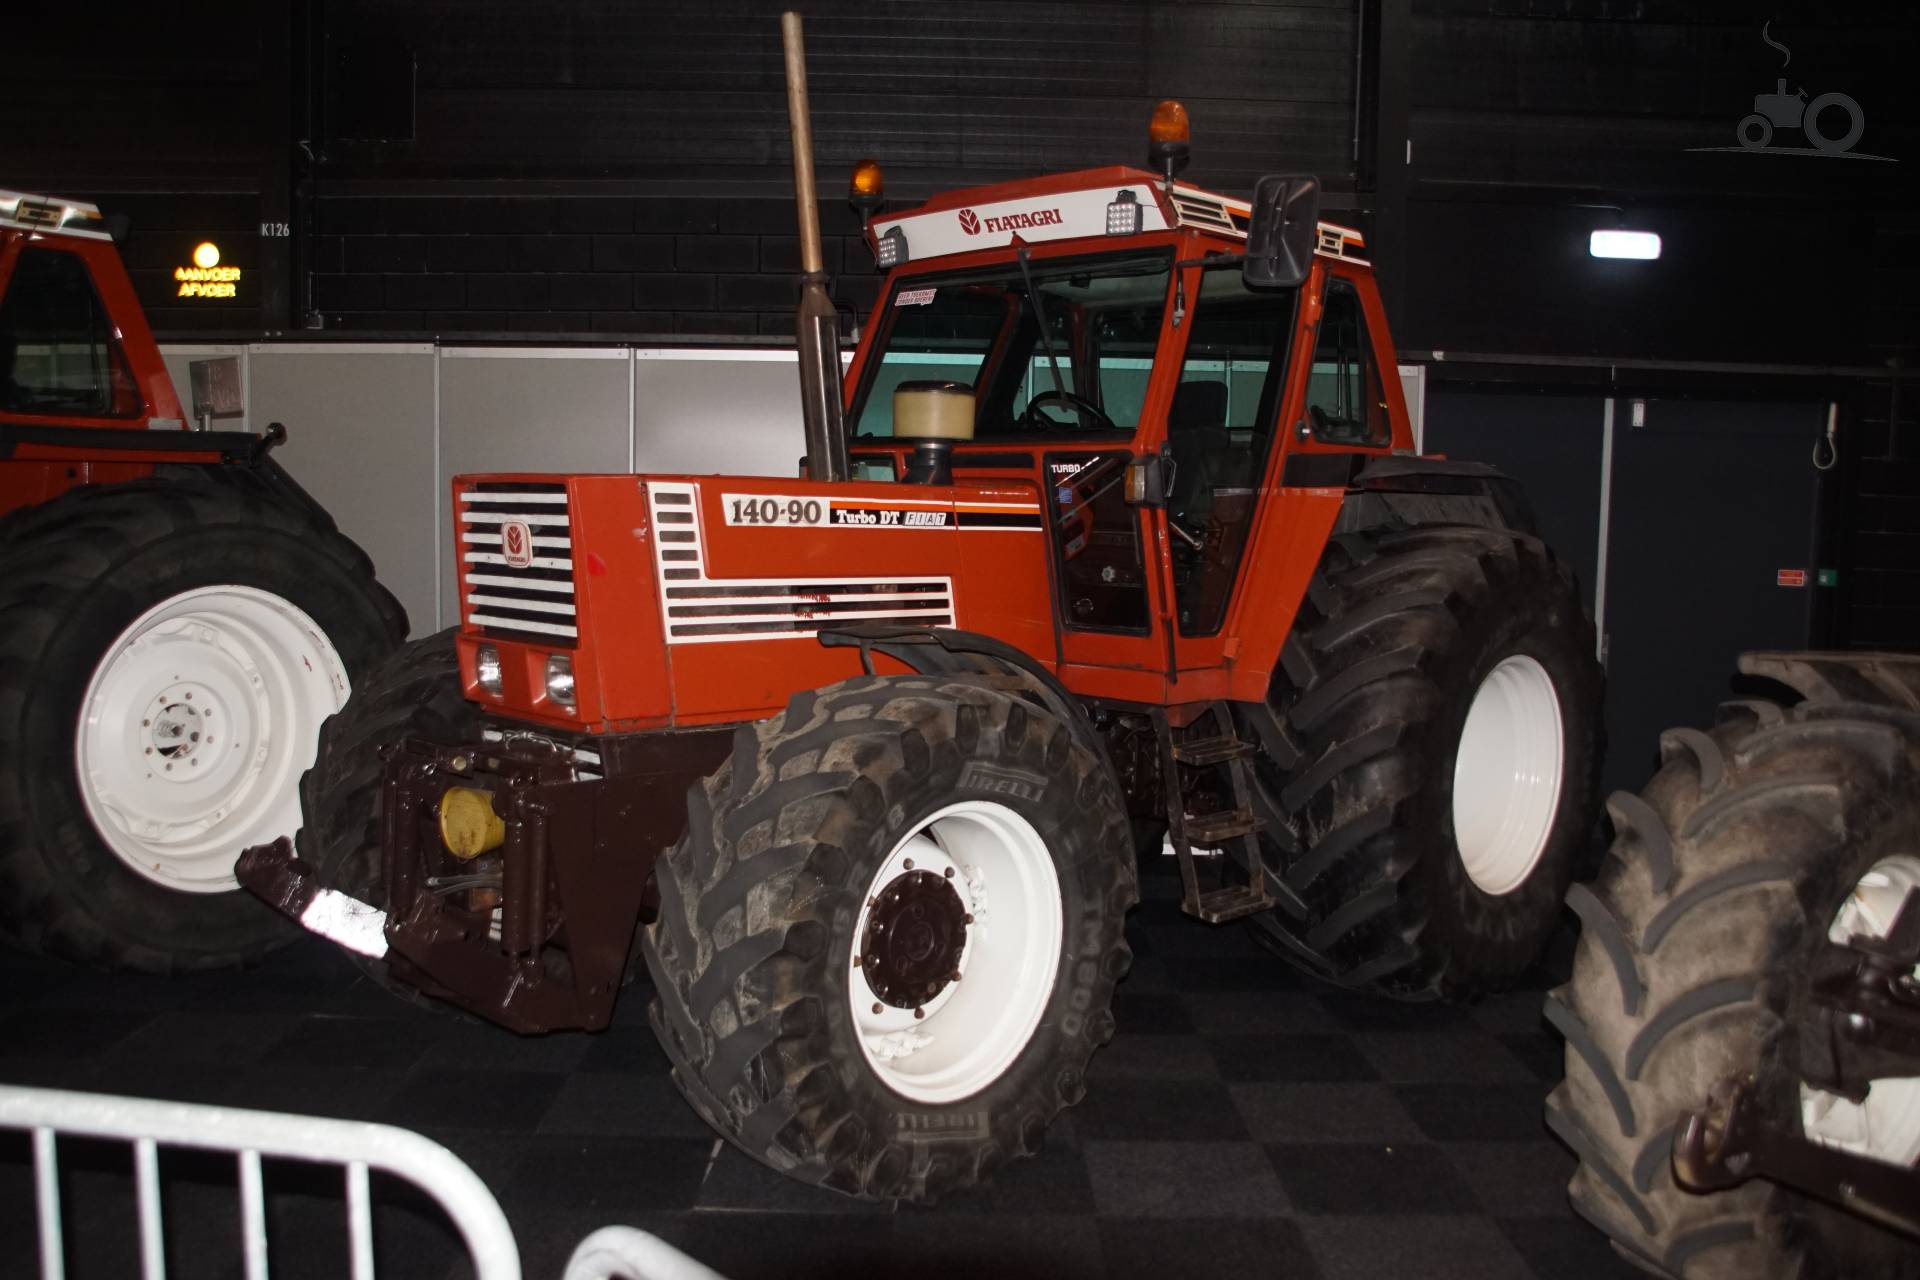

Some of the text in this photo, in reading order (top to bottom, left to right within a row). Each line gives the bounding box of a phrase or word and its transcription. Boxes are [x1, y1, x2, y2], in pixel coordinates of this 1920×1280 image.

[984, 208, 1064, 233] FIATAGRI
[261, 223, 290, 237] K126
[175, 267, 241, 281] AANVOER
[178, 283, 236, 297] AFVOER
[1051, 463, 1081, 473] TURBO
[732, 499, 947, 526] 140-90 Turbo DT FIAT
